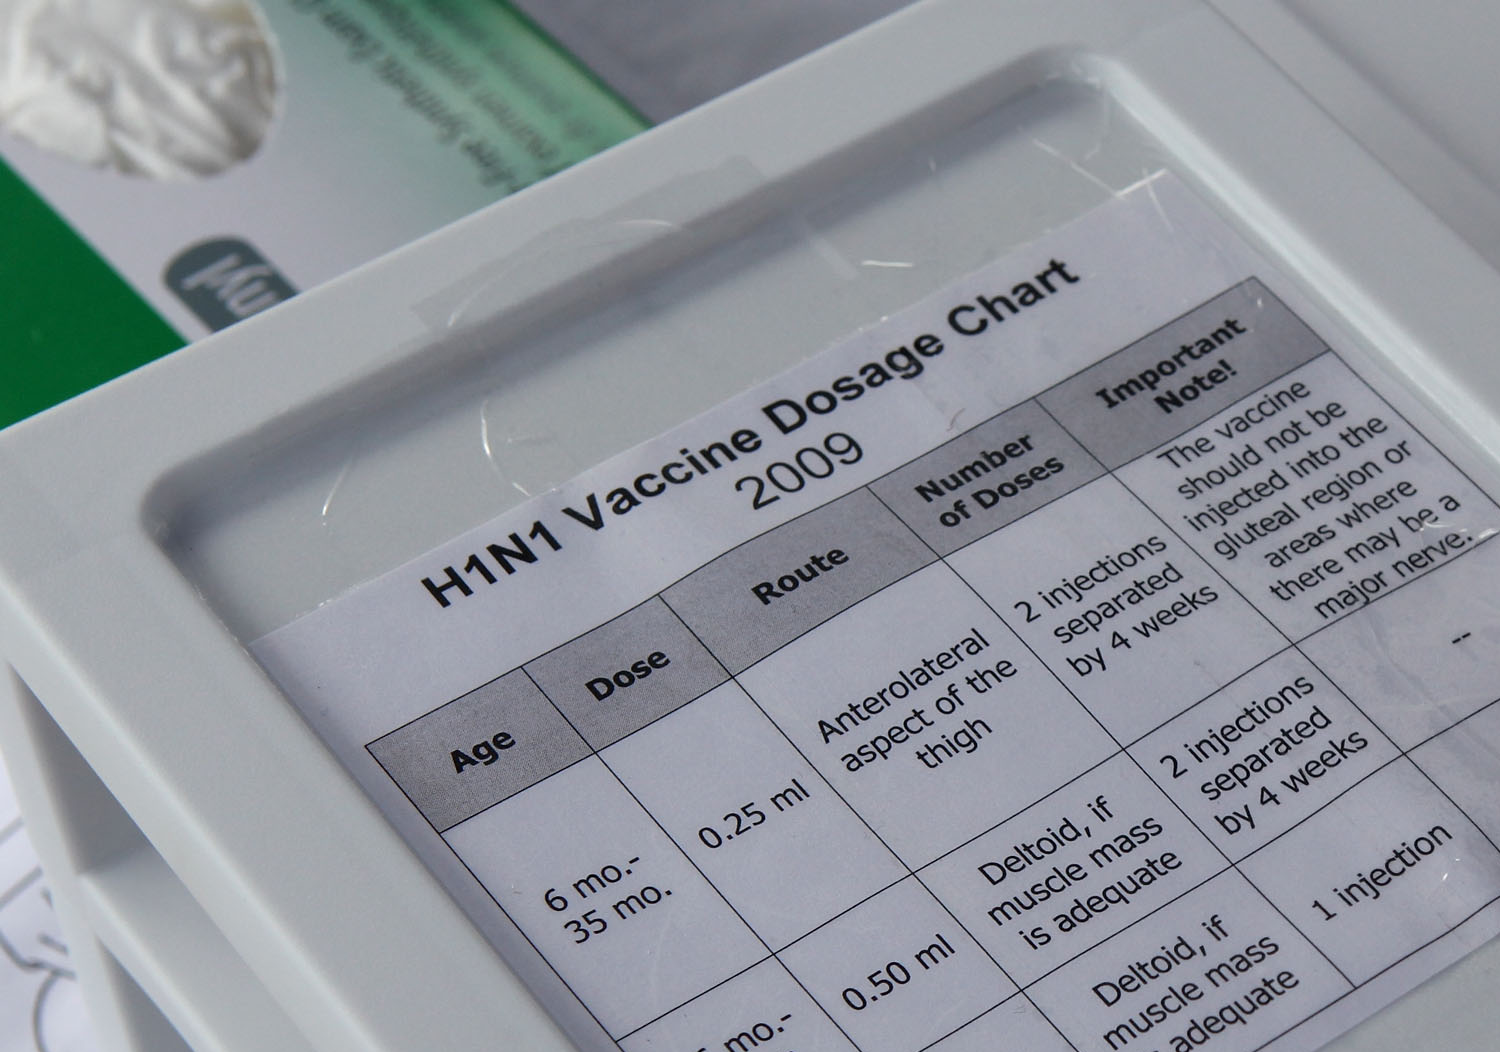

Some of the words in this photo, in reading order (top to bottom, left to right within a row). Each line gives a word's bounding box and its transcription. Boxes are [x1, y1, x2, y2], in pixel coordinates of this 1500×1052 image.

[1094, 319, 1247, 409] Important
[1153, 358, 1238, 415] Note!
[420, 519, 563, 609] H1N1
[560, 428, 763, 532] Vaccine
[760, 333, 945, 436] Dosage
[946, 258, 1081, 337] Chart
[913, 434, 1034, 503] Number
[1156, 437, 1216, 469] The
[1215, 382, 1311, 439] vaccine
[1177, 443, 1264, 501] should
[1263, 420, 1312, 454] not
[1305, 402, 1347, 428] be
[734, 431, 864, 511] 2009
[939, 499, 972, 528] of
[970, 457, 1065, 510] Doses
[1182, 468, 1290, 533] injected
[1285, 444, 1341, 479] into
[1338, 417, 1389, 449] the
[1213, 501, 1301, 561] gluteal
[1301, 460, 1384, 511] region
[1383, 439, 1412, 465] or
[1263, 524, 1337, 569] areas
[1335, 481, 1418, 529] where
[1268, 558, 1344, 602] there
[1343, 526, 1401, 564] may
[1397, 508, 1439, 533] be
[1438, 494, 1462, 513] a
[750, 549, 850, 606] Route
[1013, 600, 1042, 624] 2
[1037, 535, 1168, 610] injections
[1053, 561, 1184, 645] separated
[1313, 570, 1389, 620] major
[1391, 533, 1474, 578] nerve.
[584, 651, 671, 702] Dose
[1065, 646, 1107, 678] by
[1110, 630, 1132, 650] 4
[1131, 585, 1219, 639] weeks
[817, 627, 991, 745] Anterolateral
[840, 708, 935, 773] aspect
[934, 682, 965, 716] of
[964, 659, 1018, 695] the
[1159, 754, 1189, 780] 2
[1183, 676, 1315, 764] injections
[450, 731, 517, 775] Age
[915, 718, 993, 769] thigh
[1200, 704, 1333, 802] separated
[1213, 803, 1256, 836] by
[1259, 785, 1281, 806] 4
[1279, 731, 1369, 794] weeks
[697, 801, 767, 850] 0.25
[769, 777, 811, 813] ml
[977, 814, 1093, 886] Deltoid,
[1086, 794, 1114, 823] if
[543, 887, 569, 913] 6
[572, 856, 640, 899] mo.-
[563, 908, 608, 945] 35
[611, 885, 673, 921] mo.
[987, 863, 1089, 927] muscle
[1088, 817, 1164, 869] mass
[1018, 926, 1052, 951] is
[1052, 851, 1183, 933] adequate
[1311, 899, 1338, 922] 1
[1332, 825, 1453, 907] injection
[841, 961, 912, 1011] 0.50
[914, 933, 956, 971] ml
[1091, 935, 1207, 1008] Deltoid,
[1201, 913, 1229, 942] if
[1102, 982, 1205, 1052] muscle
[1204, 936, 1280, 988] mass
